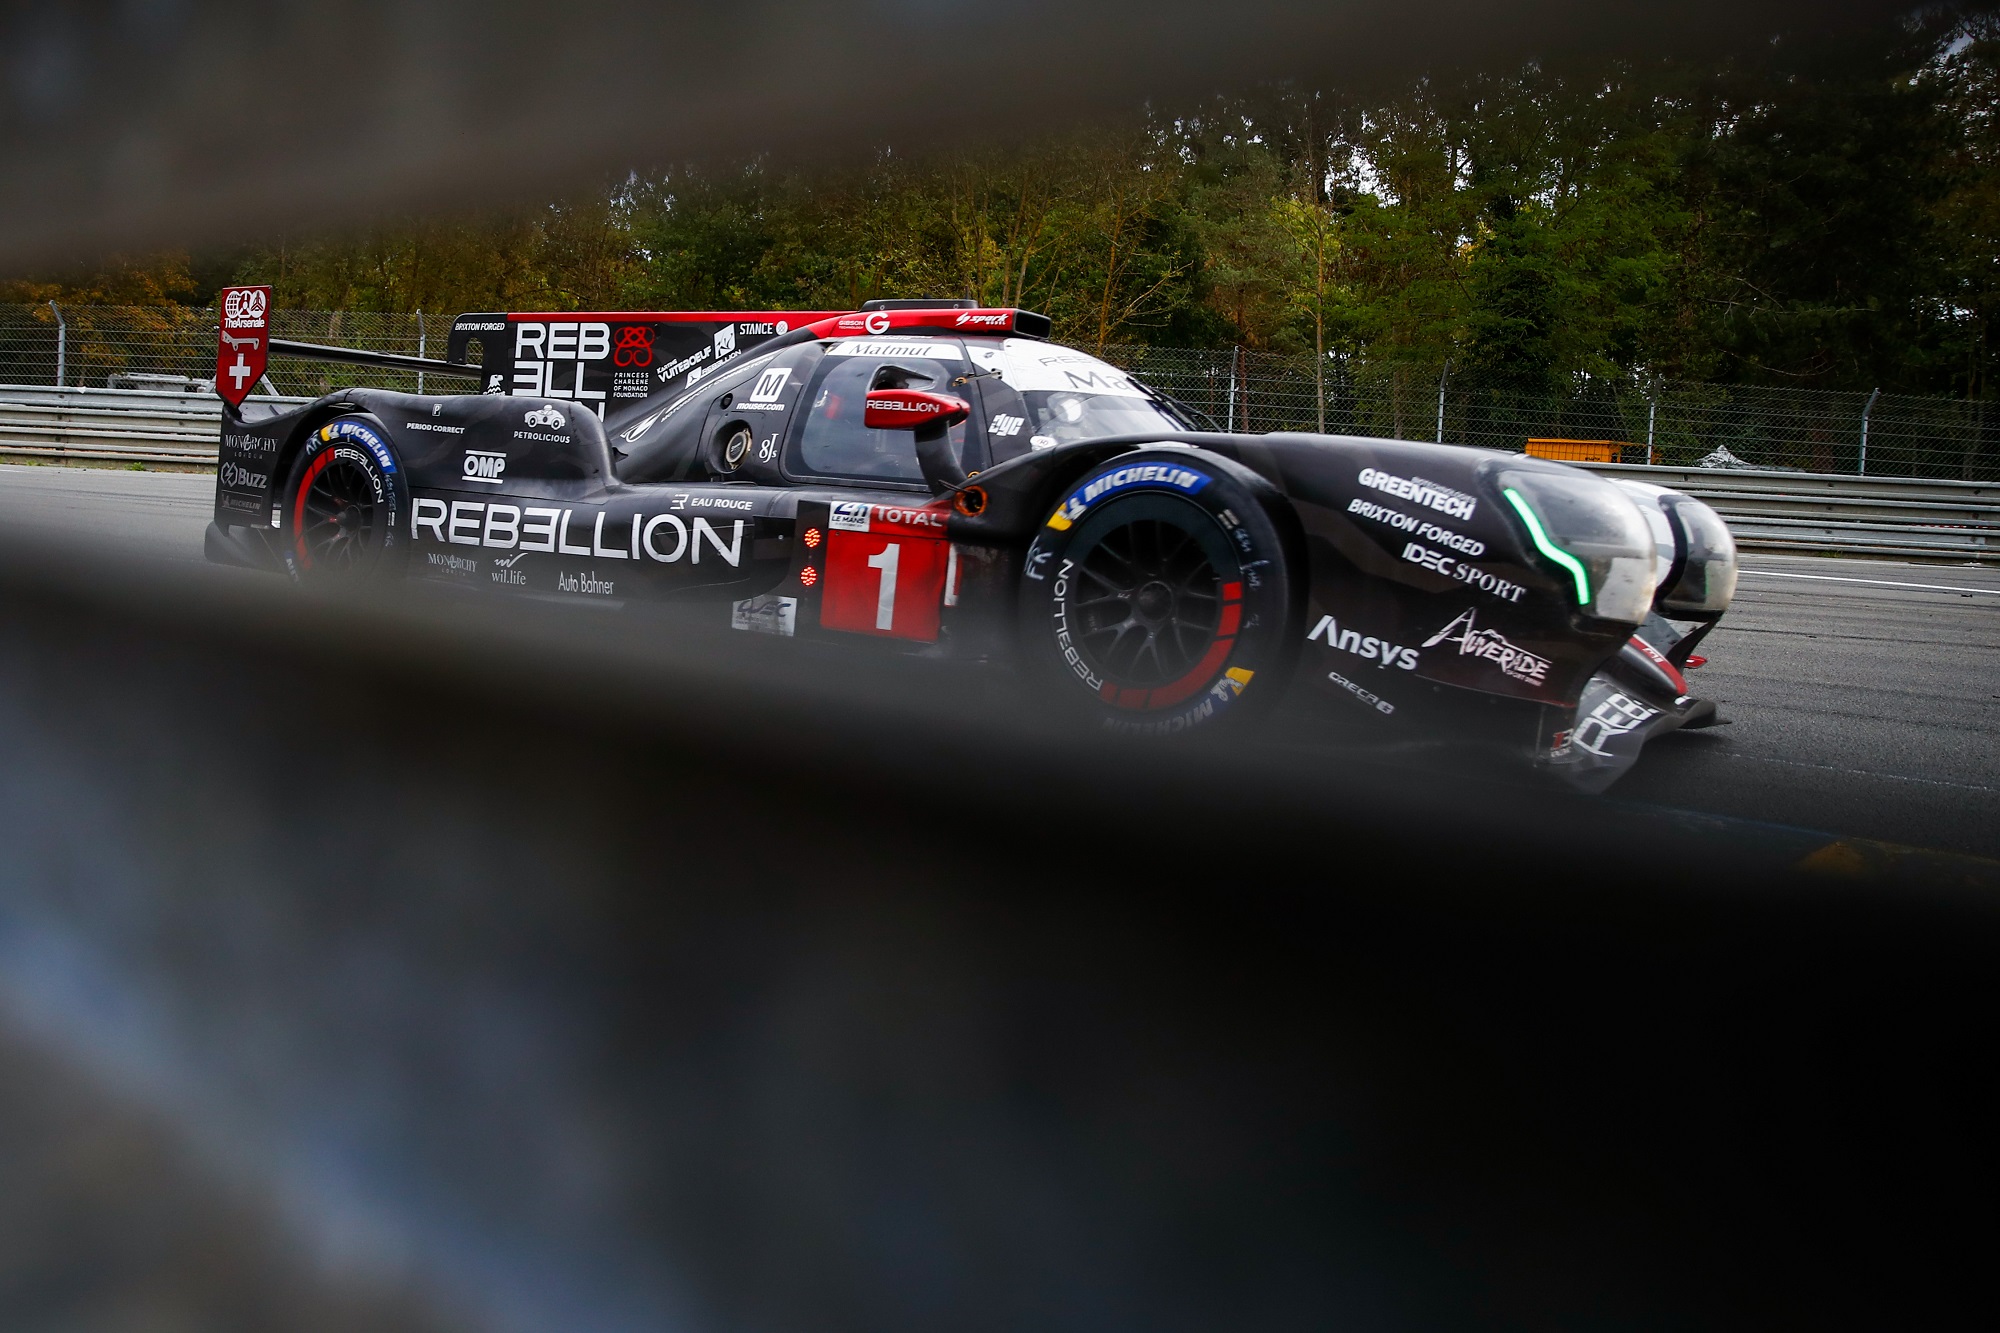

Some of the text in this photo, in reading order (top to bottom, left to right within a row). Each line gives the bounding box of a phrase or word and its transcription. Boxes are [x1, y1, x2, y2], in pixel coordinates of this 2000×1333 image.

[224, 317, 265, 329] TheArsenale
[454, 322, 505, 331] BRIXTON FORGED
[739, 323, 773, 335] STANCE
[515, 322, 610, 360] REB
[849, 344, 933, 357] Matmut
[658, 345, 712, 383] VUITEBOEUF
[736, 402, 785, 412] mouser.com
[866, 400, 940, 413] REBELLION
[406, 422, 465, 434] PERIOD CORRECT
[513, 431, 571, 444] PETROLICIOUS
[340, 423, 392, 468] MICHELIN
[334, 448, 384, 504] REBELLION
[463, 456, 506, 478] OMP
[1084, 466, 1200, 503] MICHELIN
[1358, 468, 1476, 521] GREENTECH
[691, 498, 753, 511] EAU ROUGE
[876, 505, 943, 527] TOTAL
[842, 516, 865, 524] MANS
[1347, 498, 1485, 556] BRIXTON FORGED
[411, 497, 744, 568] REBELLION
[491, 570, 527, 585] wil.life
[558, 571, 614, 595] Auto Bahner
[1402, 542, 1527, 603] IDEC SPORT
[867, 543, 900, 631] 1
[1053, 558, 1103, 691] REBELLION
[1307, 614, 1421, 670] Ansys
